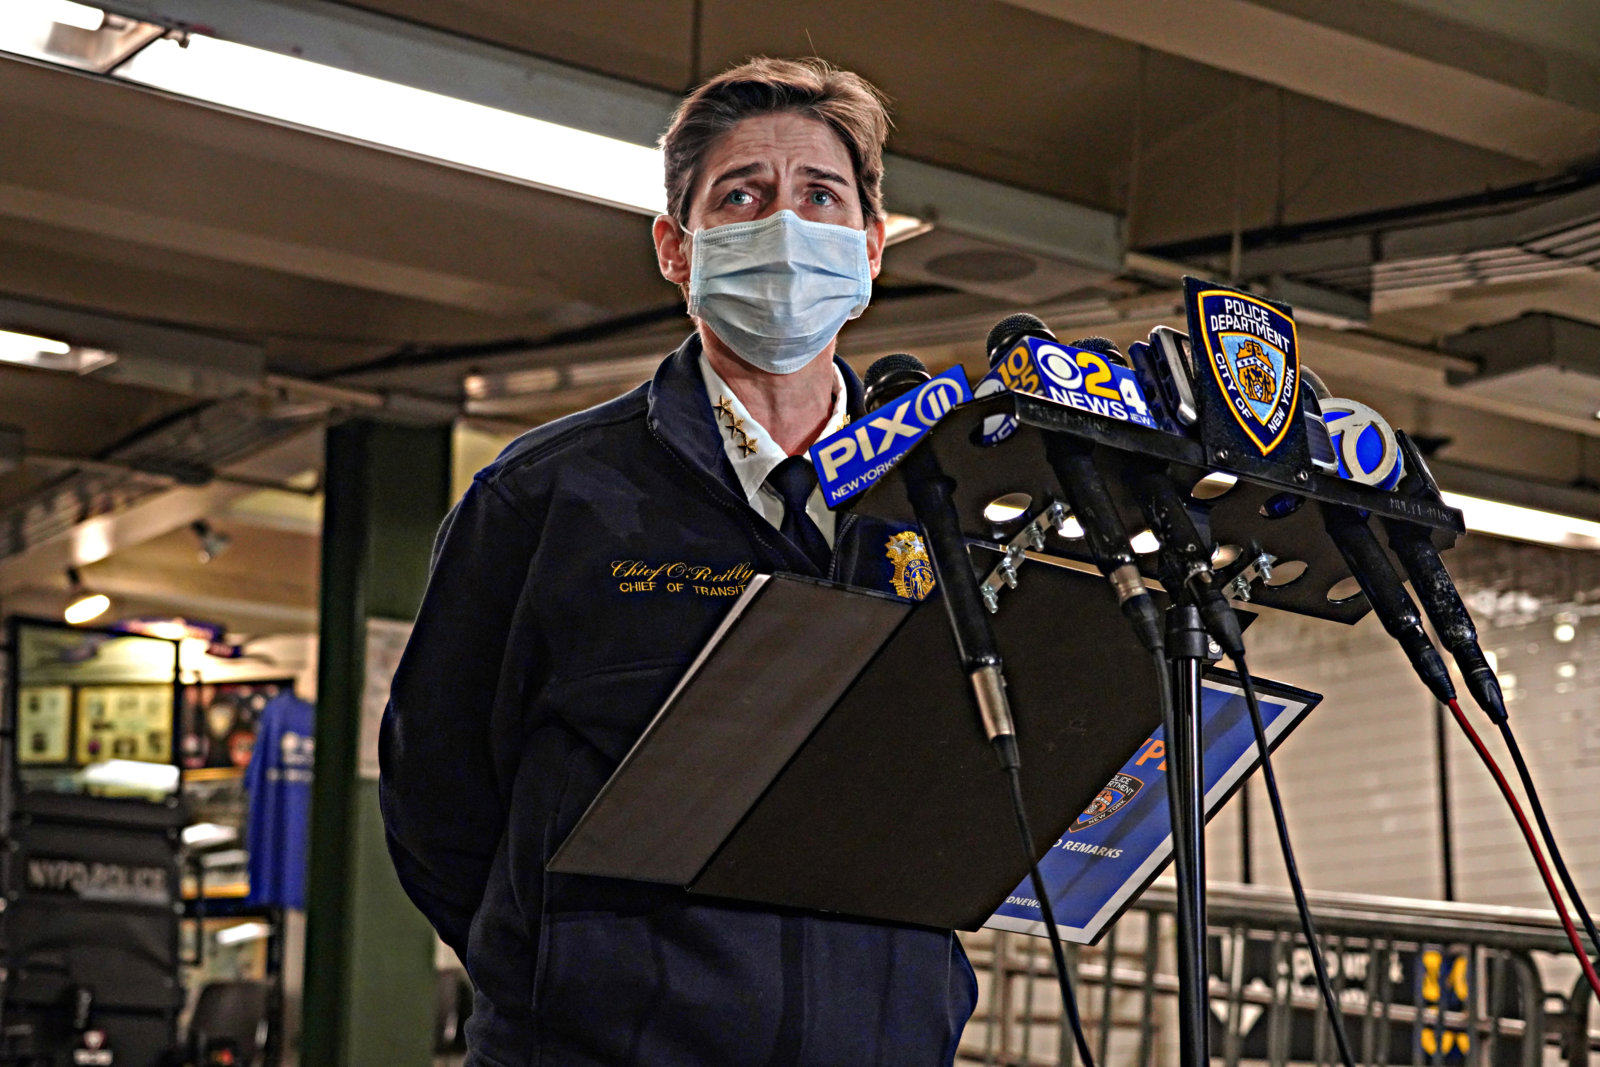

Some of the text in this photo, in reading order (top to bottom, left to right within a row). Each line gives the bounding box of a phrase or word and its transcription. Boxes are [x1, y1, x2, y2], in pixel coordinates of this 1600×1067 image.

[1224, 298, 1271, 327] POLICE
[1210, 314, 1290, 353] DEPARTMENT
[997, 346, 1029, 387] 10
[1075, 351, 1122, 401] 2
[1049, 385, 1129, 421] NEWS
[1119, 377, 1148, 416] 4
[1215, 353, 1253, 419] CITY OF
[1267, 365, 1295, 434] NEW YORK
[818, 400, 922, 483] PIX
[831, 478, 859, 501] NEW
[611, 560, 670, 582] Chief
[619, 581, 749, 596] CHIEF OF TRANSIT
[1088, 799, 1127, 825] NEW YORK
[1062, 840, 1124, 859] REMARKS
